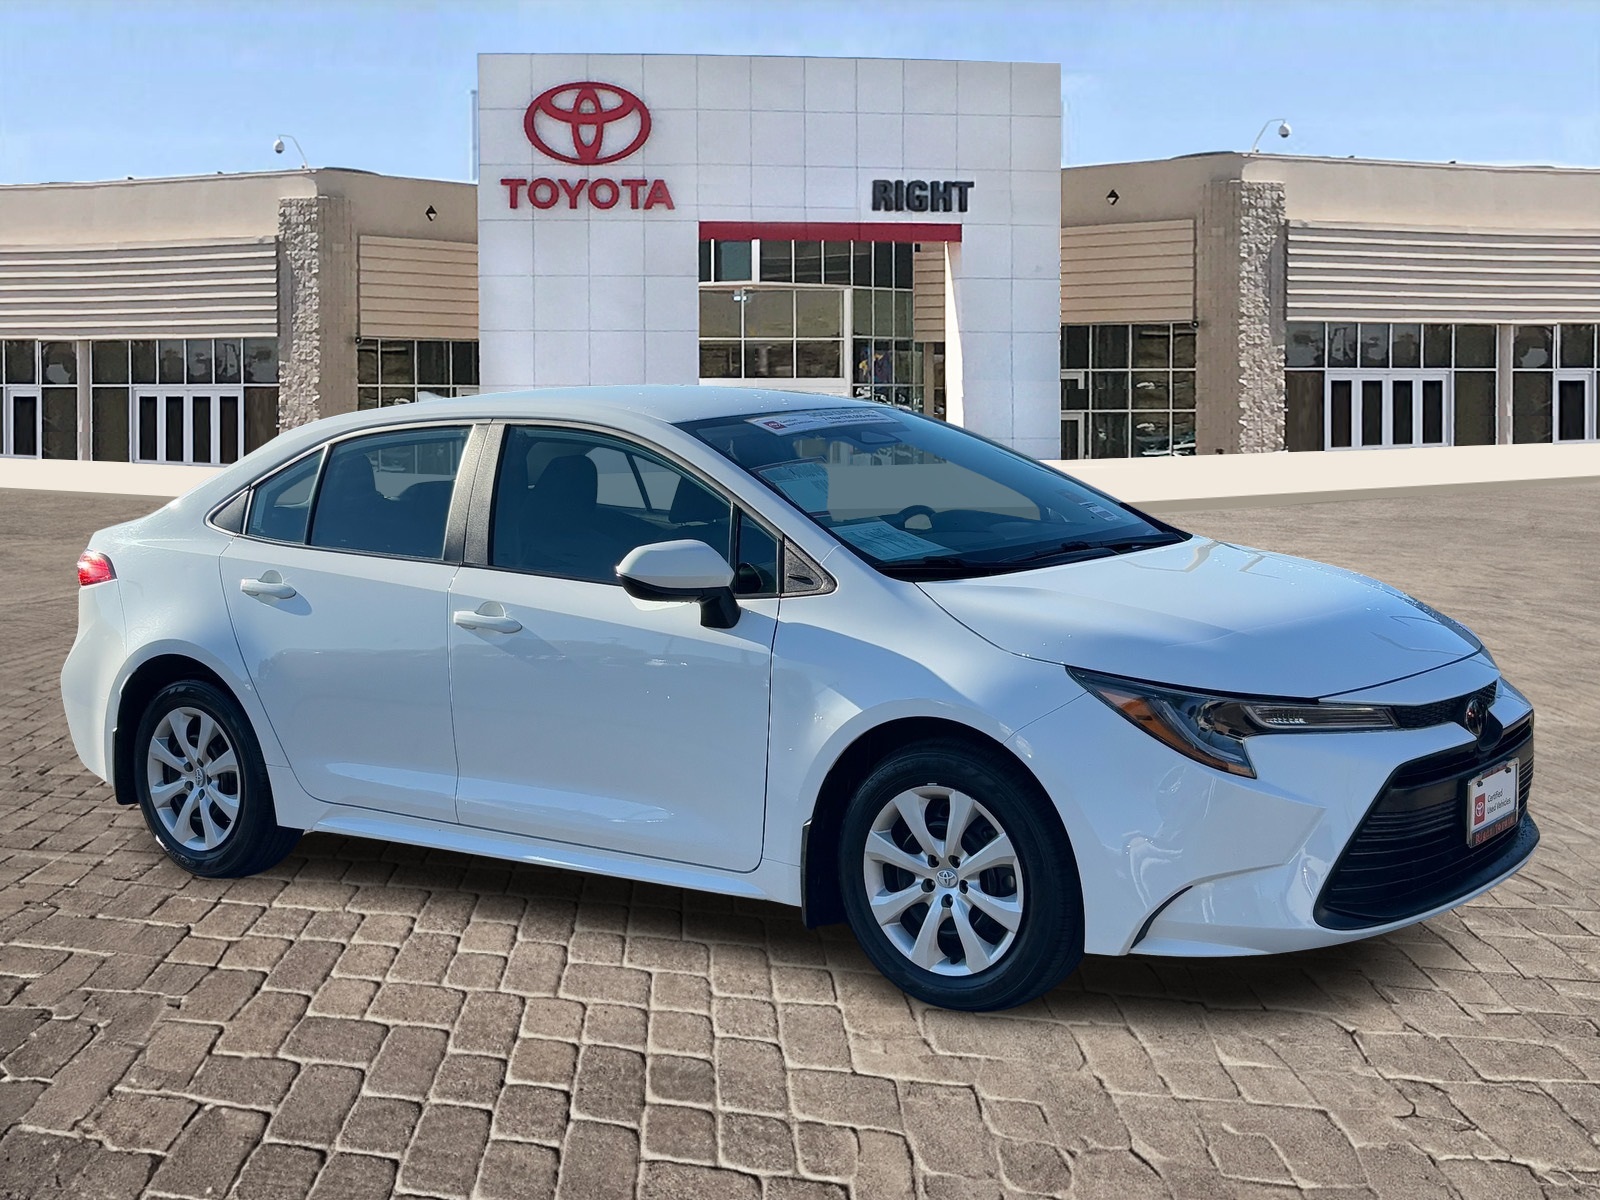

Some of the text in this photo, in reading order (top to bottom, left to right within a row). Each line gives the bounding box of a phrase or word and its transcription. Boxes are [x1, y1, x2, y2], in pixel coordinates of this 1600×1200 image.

[500, 178, 675, 210] TOYOTA
[871, 180, 975, 213] RIGHT
[1487, 789, 1503, 803] Certified
[1487, 797, 1512, 815] Used Vehicles
